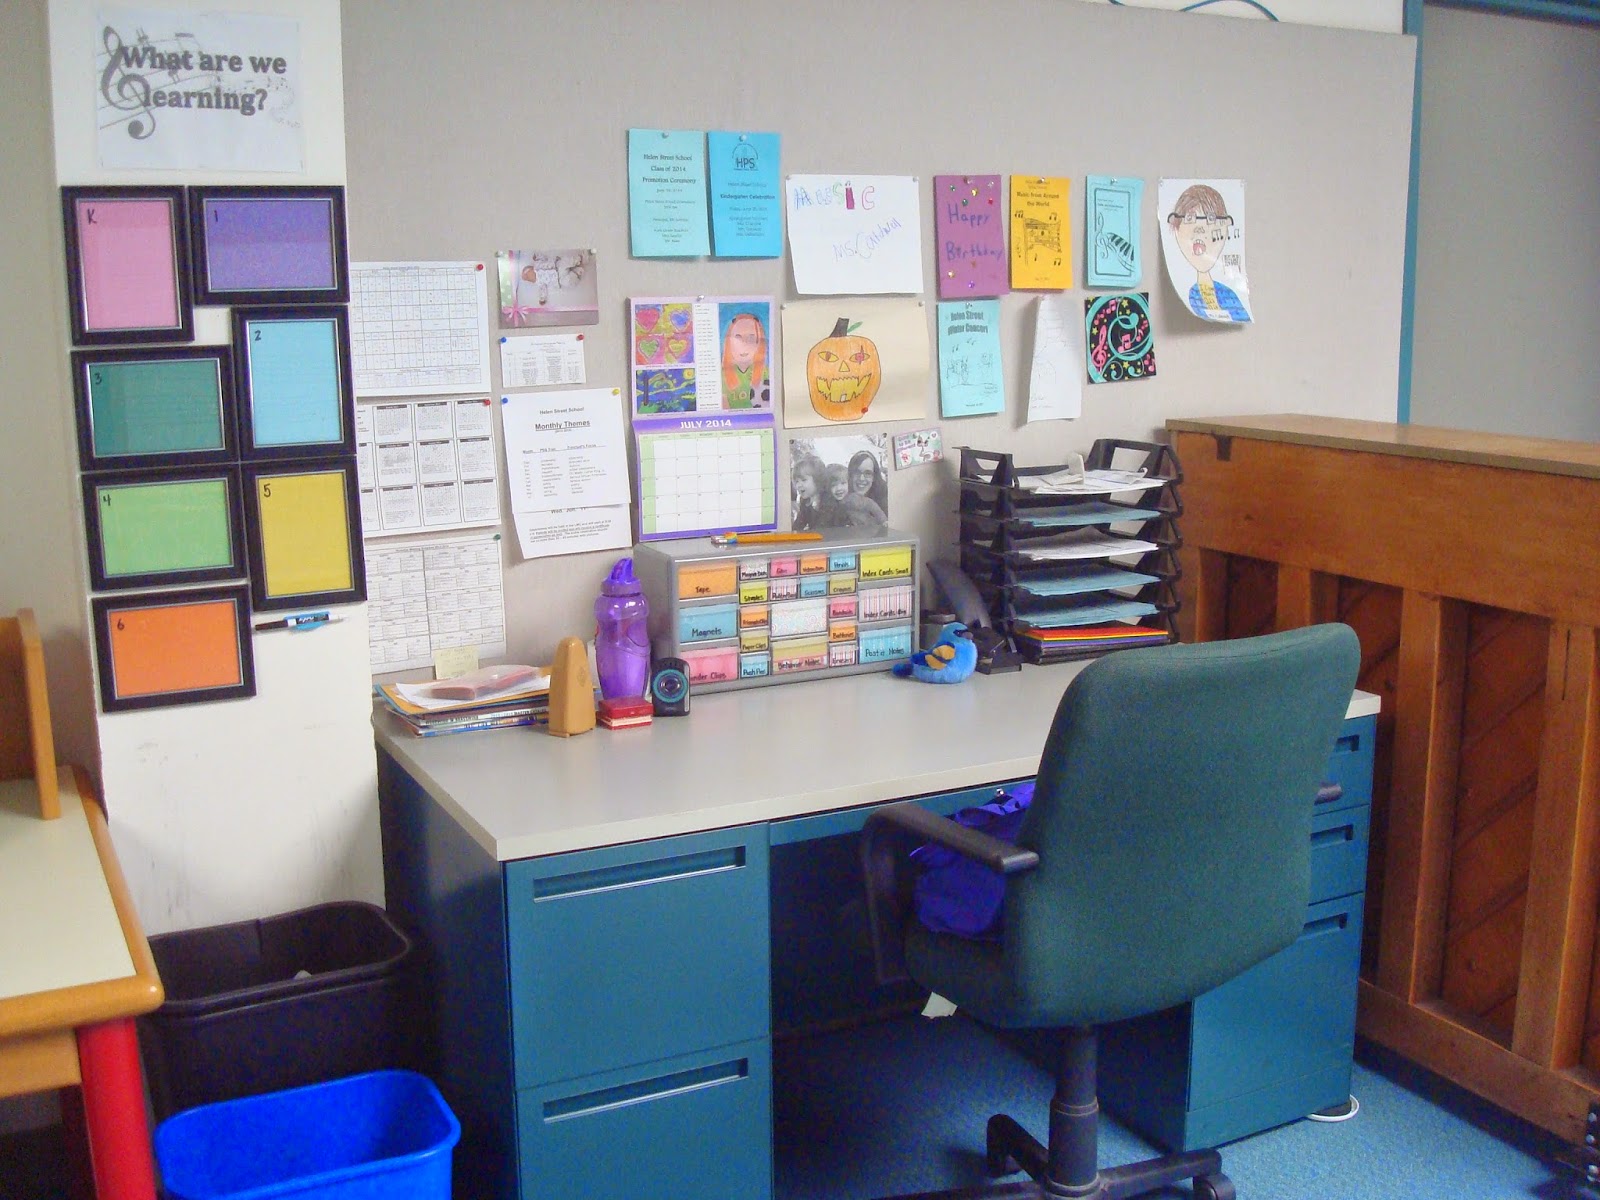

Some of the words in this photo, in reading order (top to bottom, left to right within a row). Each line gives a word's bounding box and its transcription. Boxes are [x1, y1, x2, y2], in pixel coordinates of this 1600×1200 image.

[121, 46, 193, 71] What
[200, 52, 243, 72] are
[250, 55, 287, 74] we
[736, 157, 756, 169] HPS
[87, 208, 97, 225] K
[213, 210, 219, 222] 1
[947, 202, 992, 228] Happy
[254, 330, 262, 342] 2
[94, 373, 103, 385] 3
[535, 421, 562, 430] Monthly
[564, 420, 591, 428] Themes
[680, 421, 703, 429] JULY
[706, 419, 732, 428] 2014
[263, 483, 272, 498] 5
[102, 493, 112, 507] 4
[695, 585, 711, 595] Tape
[117, 618, 125, 630] 6
[691, 627, 723, 637] Magnets
[865, 648, 880, 657] Post
[889, 647, 905, 656] Notes
[711, 671, 727, 680] Clips
